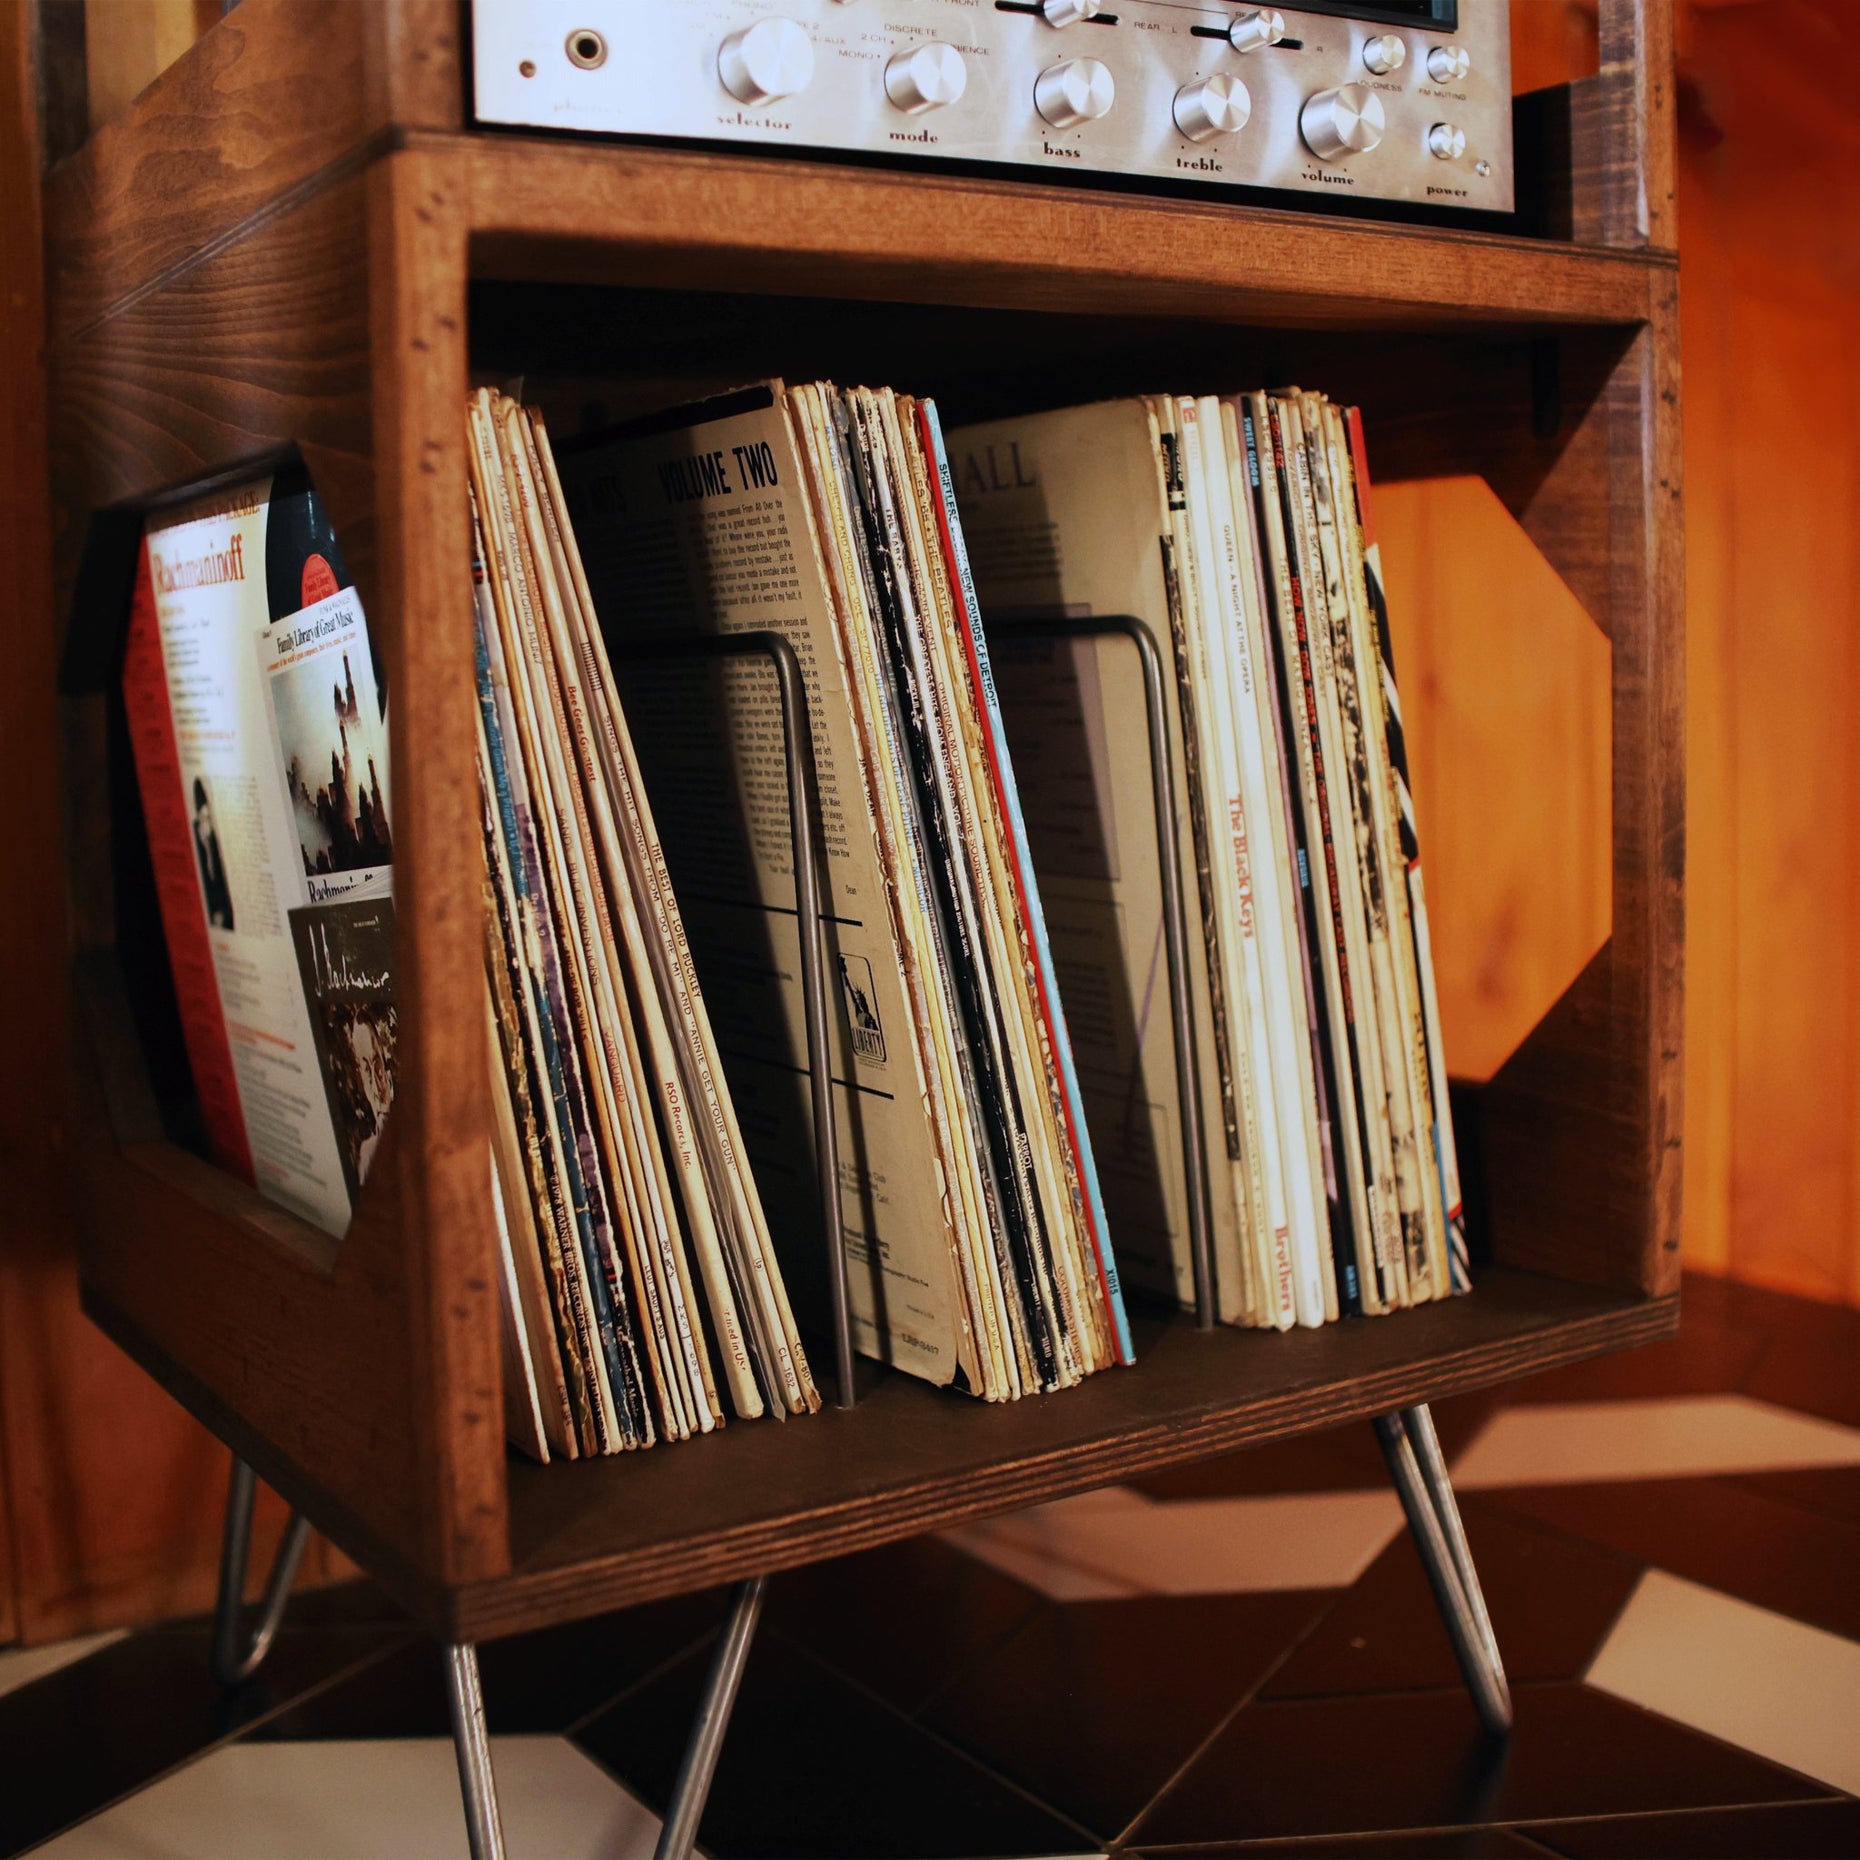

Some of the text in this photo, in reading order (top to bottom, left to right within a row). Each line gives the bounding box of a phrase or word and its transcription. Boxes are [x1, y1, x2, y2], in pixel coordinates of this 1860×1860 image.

[884, 23, 938, 37] DISCRETE
[1134, 22, 1161, 31] REAR
[838, 49, 874, 60] MONO
[1434, 90, 1467, 101] MUTING
[717, 112, 793, 131] selector
[889, 128, 940, 145] mode
[1042, 142, 1082, 160] bass
[1176, 157, 1224, 174] treble
[1300, 168, 1355, 187] volume
[1426, 185, 1469, 198] power
[1242, 415, 1260, 486] SWEET GLOOM
[1294, 440, 1309, 482] CABIN
[657, 451, 732, 503] VOLUME
[732, 441, 779, 491] TWO
[741, 497, 782, 514] From Over the
[1300, 485, 1311, 499] IN
[837, 524, 849, 547] AND
[883, 507, 904, 571] THE BABYS
[1307, 533, 1319, 558] SKY
[505, 529, 523, 574] MARCO
[515, 576, 534, 628] ANTONIO
[842, 549, 857, 587] CHONG
[925, 535, 939, 563] THE
[932, 567, 953, 629] BEATLES
[958, 566, 973, 594] NEW
[1288, 575, 1302, 608] HOW
[1312, 569, 1325, 600] NEW
[964, 595, 983, 642] SOUNDS
[1221, 523, 1252, 694] QUEEN A NIGHT AT THE OPERA
[276, 629, 295, 655] Family
[294, 626, 315, 649] Library
[320, 618, 336, 637] Great
[974, 642, 987, 660] OF
[861, 643, 875, 674] 77010
[1298, 649, 1311, 680] DOW
[1321, 644, 1333, 678] CAST
[872, 671, 884, 692] THE
[907, 678, 918, 700] ROCKY
[978, 661, 997, 709] DETROIT
[877, 693, 893, 737] GOLDEN
[1303, 683, 1316, 725] JONES
[886, 739, 898, 764] HITS
[891, 765, 901, 779] OF
[864, 790, 877, 818] DEAN
[894, 780, 907, 809] GENE
[911, 864, 928, 913] MUSICOR
[912, 613, 1032, 1170] THE GREATEST HITS FROM ENGLAND PARROT
[565, 684, 695, 1170] Bee Gees RSO Inc.
[649, 842, 701, 999] THE BEST OF LORD BUCKLEY
[954, 910, 966, 937] PICTURE
[602, 715, 619, 754] SINGS
[615, 761, 627, 783] THE
[623, 790, 635, 811] HIT
[630, 817, 649, 860] SONGS
[644, 866, 661, 902] FROM
[663, 938, 676, 956] RE
[678, 989, 693, 1016] AND
[687, 1020, 707, 1065] "ANNIE
[700, 1069, 715, 1094] GET
[709, 1098, 726, 1134] YOUR
[720, 1137, 737, 1172] GUN"
[959, 937, 970, 958] SCORE
[910, 557, 922, 580] THE
[922, 613, 937, 652] EVENT
[934, 680, 954, 737] ORIGINAL
[947, 739, 964, 785] MOTION
[957, 786, 975, 838] PICTURE
[1056, 1264, 1074, 1321] COLUMBIA
[1067, 1323, 1083, 1366] STEREO
[602, 1030, 628, 1104] VANGUARD
[1225, 793, 1294, 1311] The Black Keys Brothers
[554, 1205, 586, 1328] WARNER BROS. RECORDS
[730, 1340, 741, 1351] in
[776, 1346, 795, 1389] CL 1632
